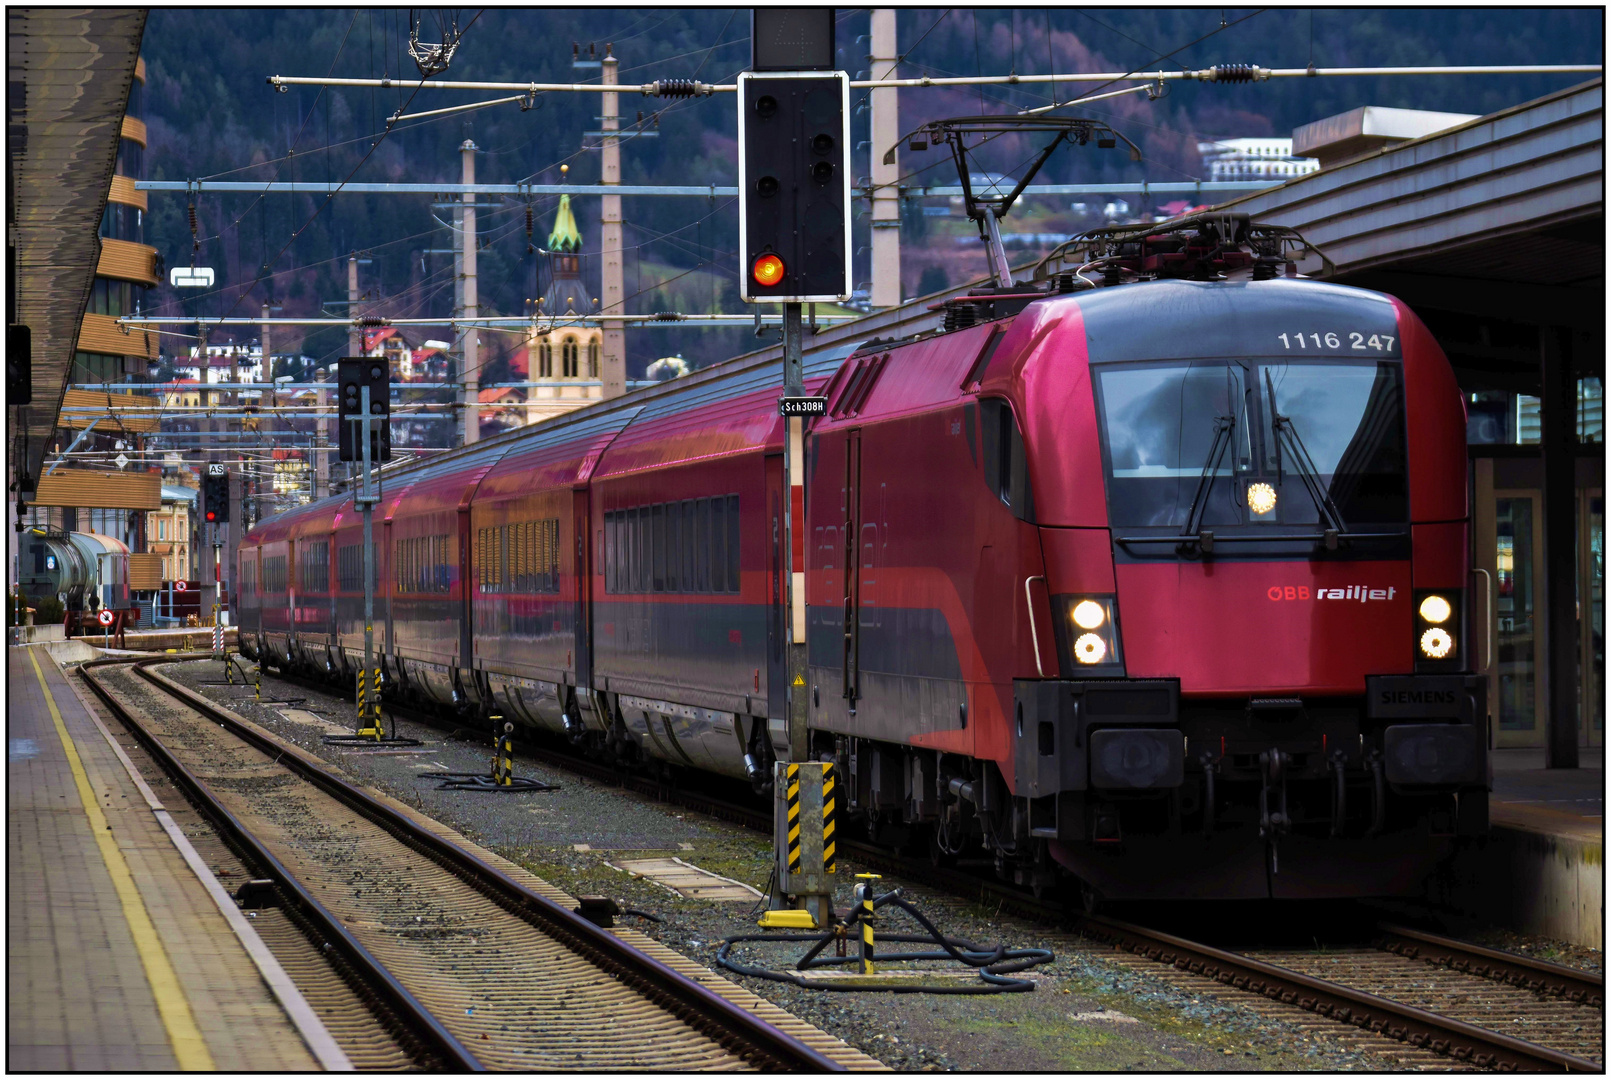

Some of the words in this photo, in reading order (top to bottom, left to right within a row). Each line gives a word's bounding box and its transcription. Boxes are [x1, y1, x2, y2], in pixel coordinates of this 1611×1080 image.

[1278, 332, 1341, 349] 1116
[1349, 332, 1395, 351] 247
[786, 402, 823, 412] Sch308H
[210, 466, 224, 474] AS
[1267, 586, 1310, 601] ÖBB
[1317, 585, 1396, 603] railjet
[1381, 690, 1455, 704] SIEMENS
